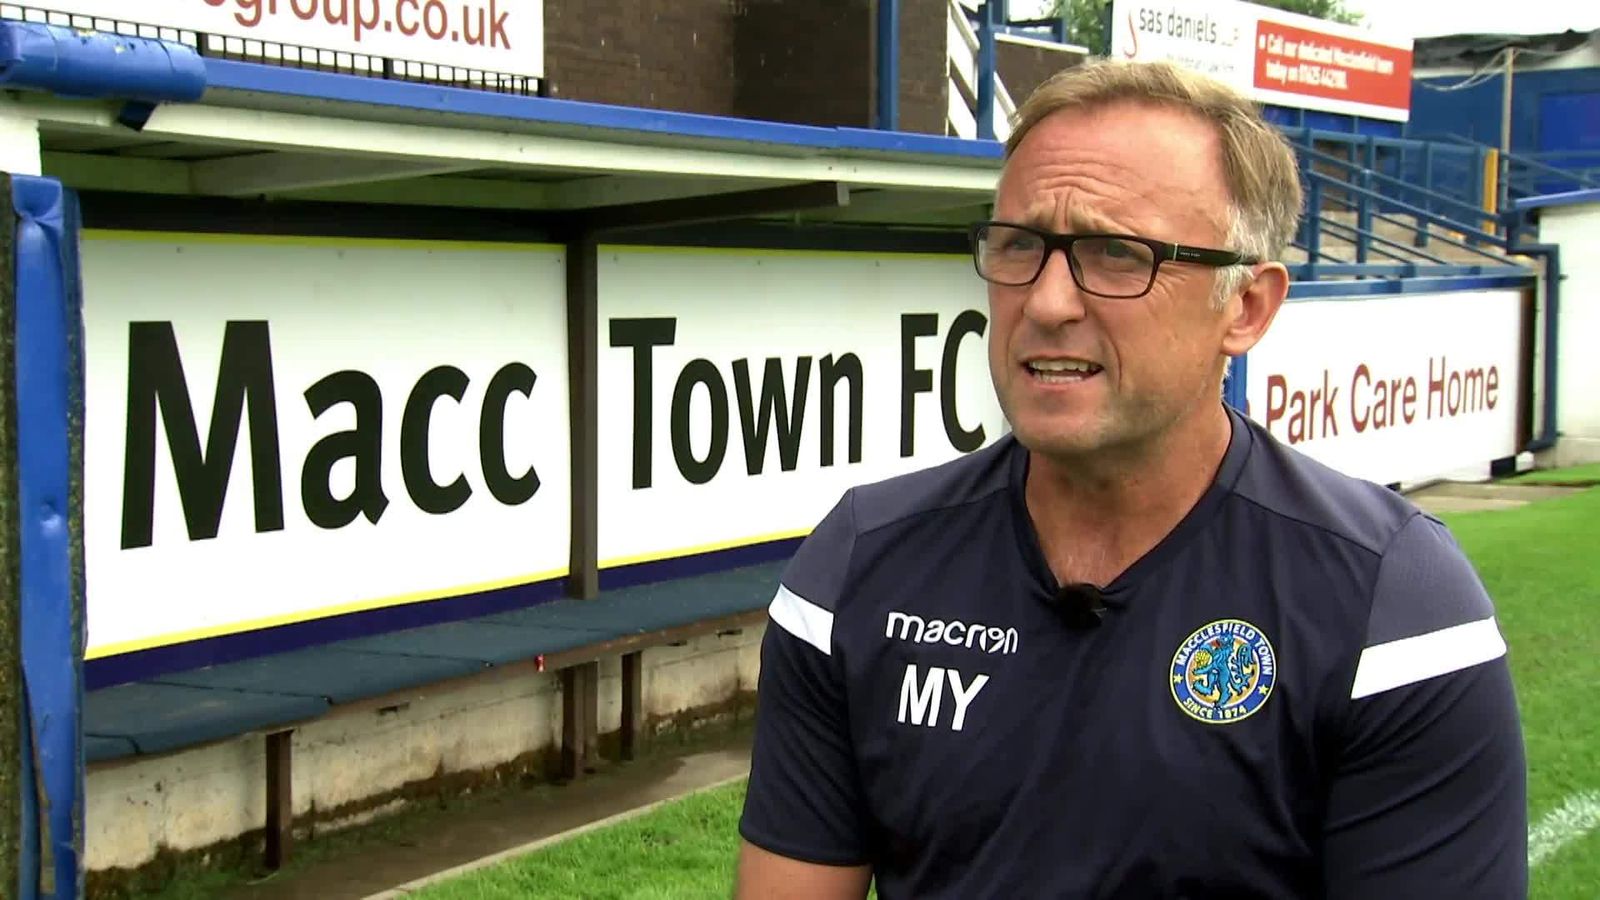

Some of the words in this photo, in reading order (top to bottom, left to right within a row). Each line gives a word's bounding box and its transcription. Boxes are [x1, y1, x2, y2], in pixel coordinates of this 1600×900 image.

[203, 0, 511, 49] goup.co.uk
[1139, 8, 1162, 34] sas
[1167, 5, 1217, 44] daniels
[1266, 369, 1339, 444] Park
[1351, 363, 1417, 433] Care
[1427, 356, 1499, 420] Home
[120, 319, 541, 550] Macc
[609, 317, 863, 490] Town
[900, 309, 988, 457] FC
[886, 611, 1019, 655] macron
[1175, 622, 1256, 666] MACCLESFIELD
[1254, 637, 1273, 676] TOWN
[897, 664, 990, 731] MY
[1183, 697, 1213, 719] SINCE
[1218, 704, 1247, 719] 1874
